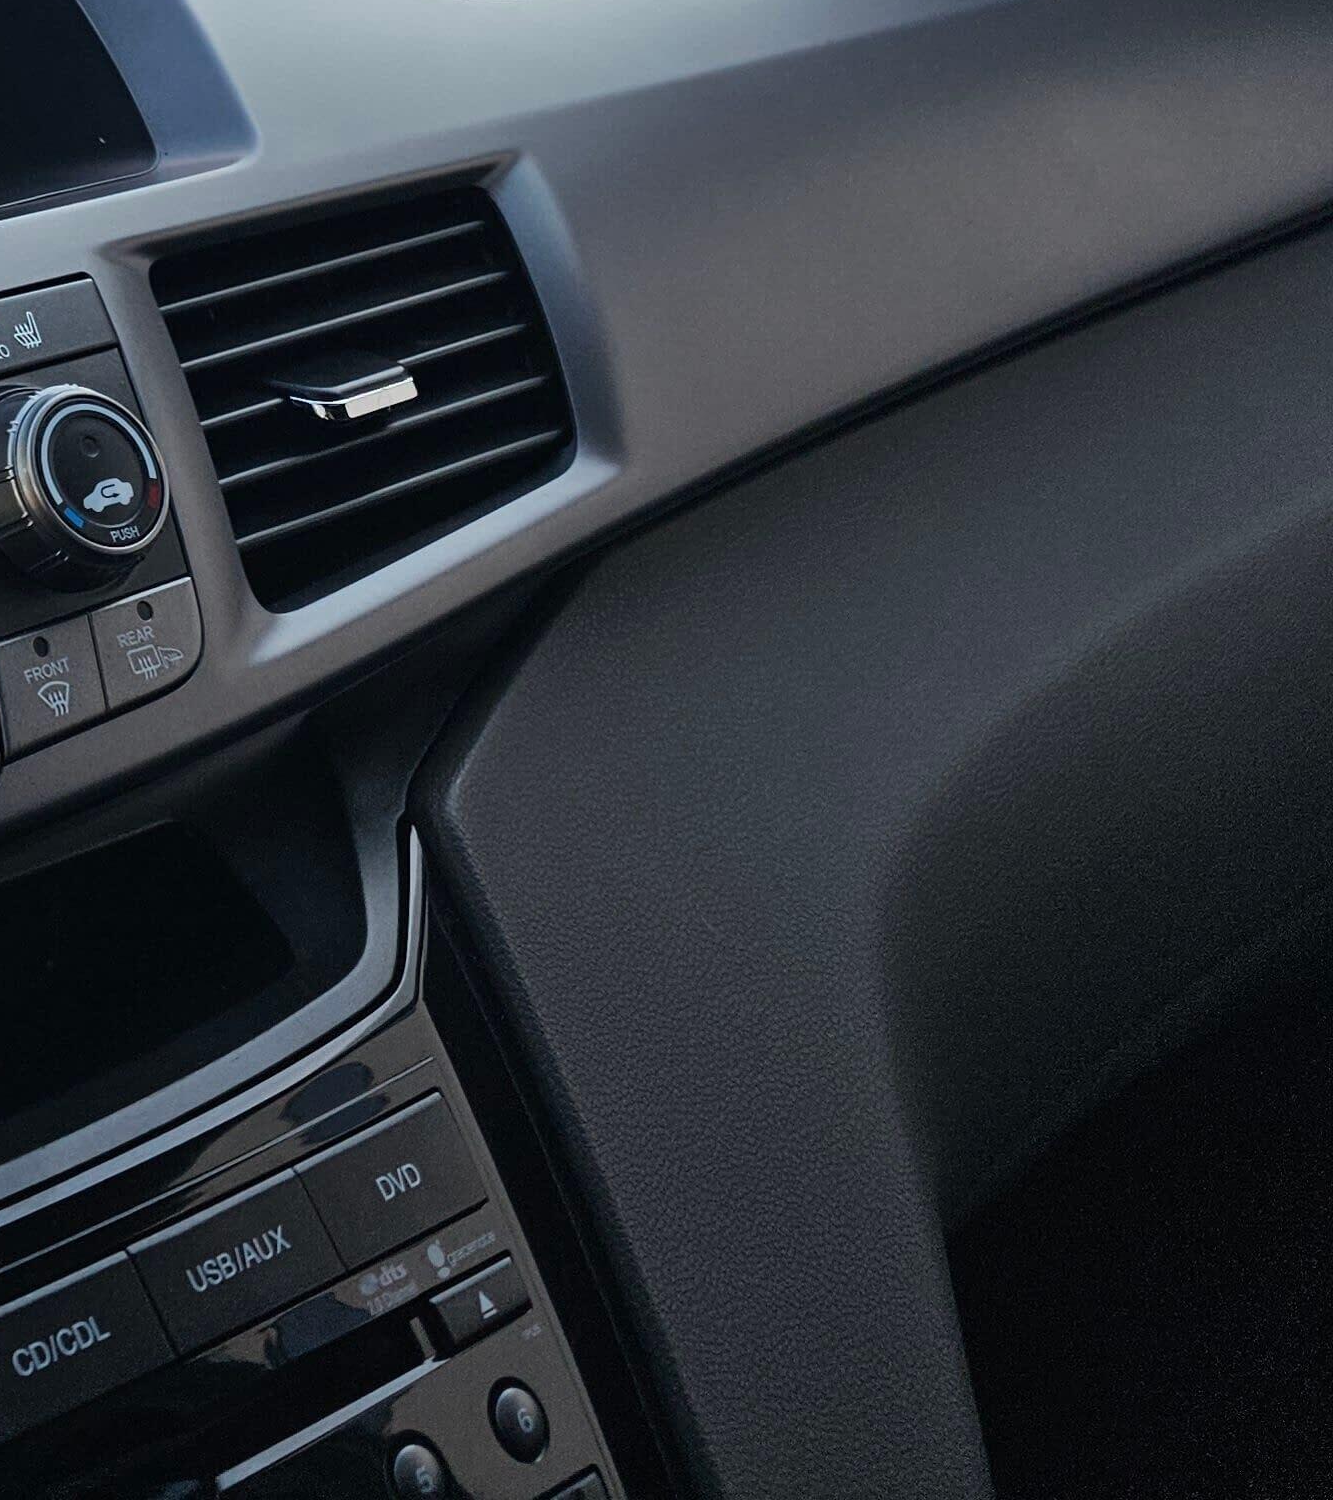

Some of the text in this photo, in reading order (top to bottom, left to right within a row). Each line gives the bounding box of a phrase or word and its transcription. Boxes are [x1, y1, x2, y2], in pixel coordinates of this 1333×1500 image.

[110, 526, 140, 543] PUSH
[116, 626, 155, 649] REAR
[24, 658, 70, 684] FRONT
[375, 1163, 422, 1201] DVD
[186, 1224, 291, 1293] USB/AUX
[12, 1315, 111, 1377] CD/CDL
[517, 1407, 533, 1433] 6
[415, 1466, 433, 1494] 5
